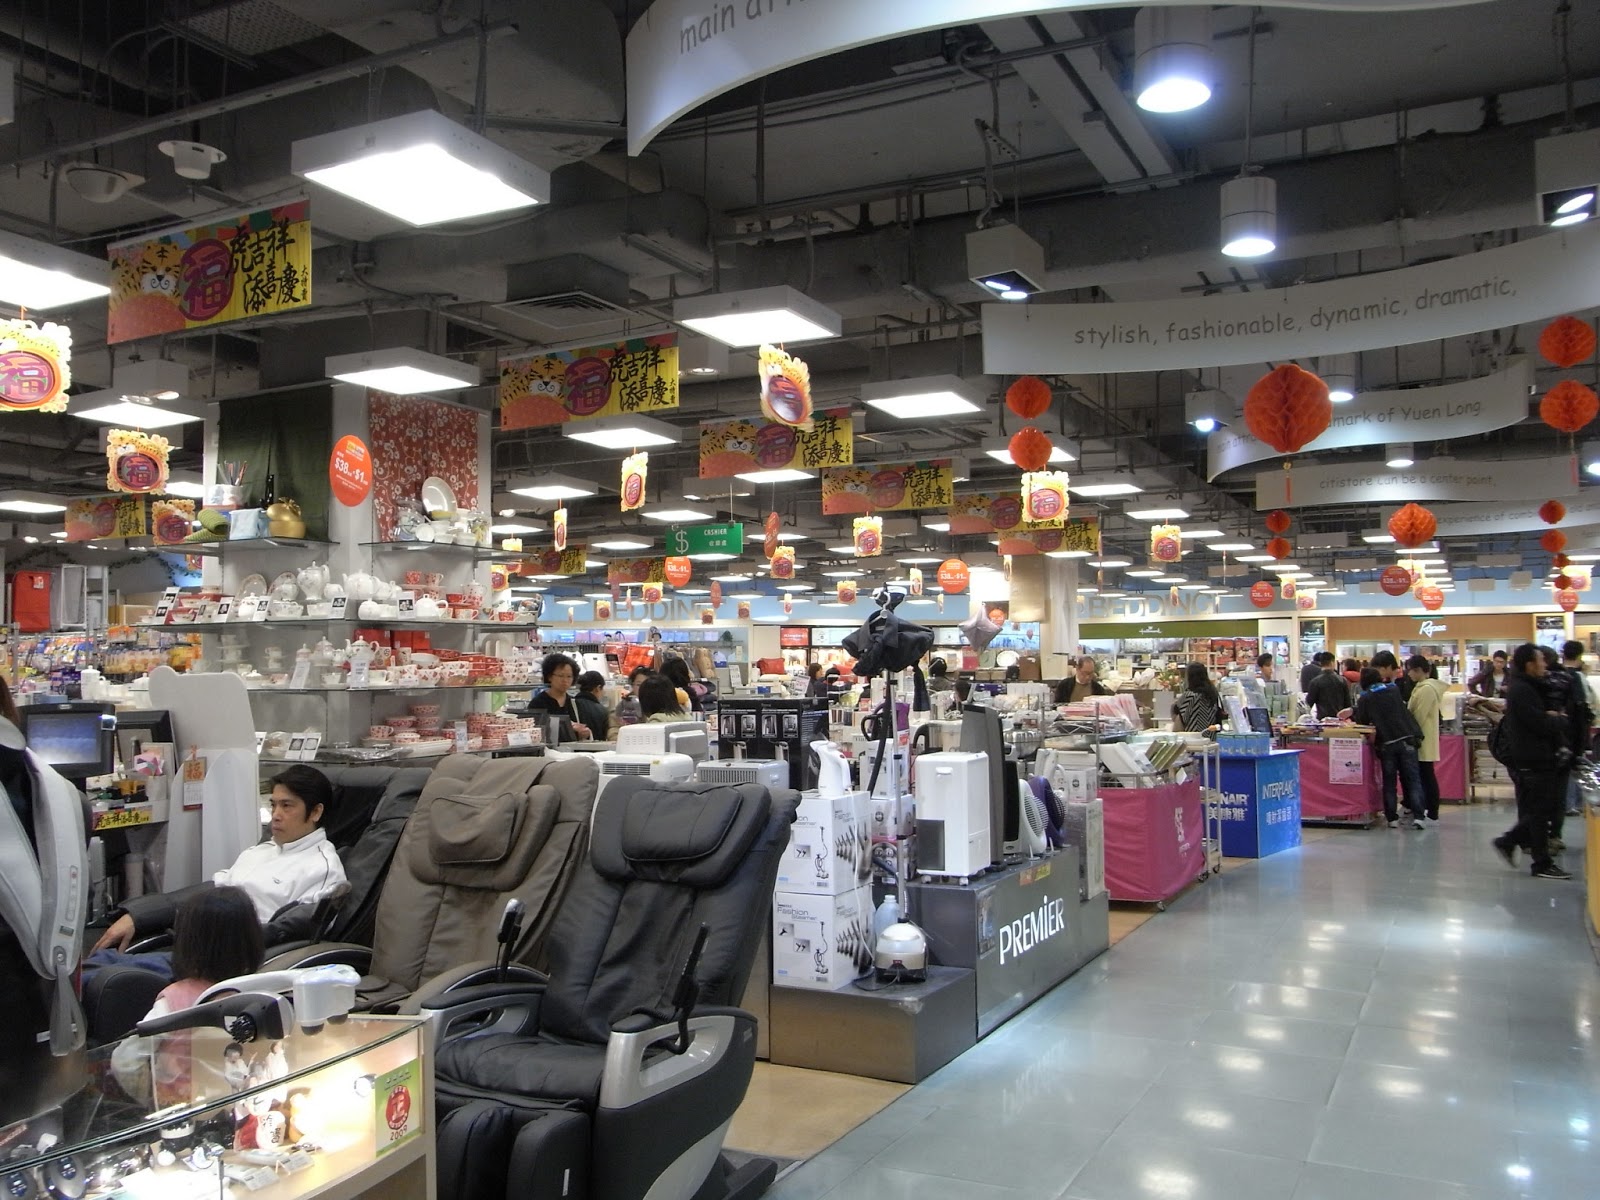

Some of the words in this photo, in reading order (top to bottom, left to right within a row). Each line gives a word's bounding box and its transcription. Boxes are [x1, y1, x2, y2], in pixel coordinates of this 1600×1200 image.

[680, 4, 734, 54] main
[1075, 325, 1157, 349] stylish,
[1166, 312, 1301, 343] fashionable,
[1310, 298, 1407, 331] dynamic,
[1415, 276, 1516, 310] dramatic,
[1329, 411, 1371, 427] mark
[1378, 407, 1394, 423] of
[1401, 407, 1440, 421] Yuen
[1447, 401, 1480, 417] Long
[1320, 477, 1372, 489] citistore
[1402, 475, 1416, 484] be
[777, 907, 808, 916] Fashion
[390, 1125, 407, 1140] 2009
